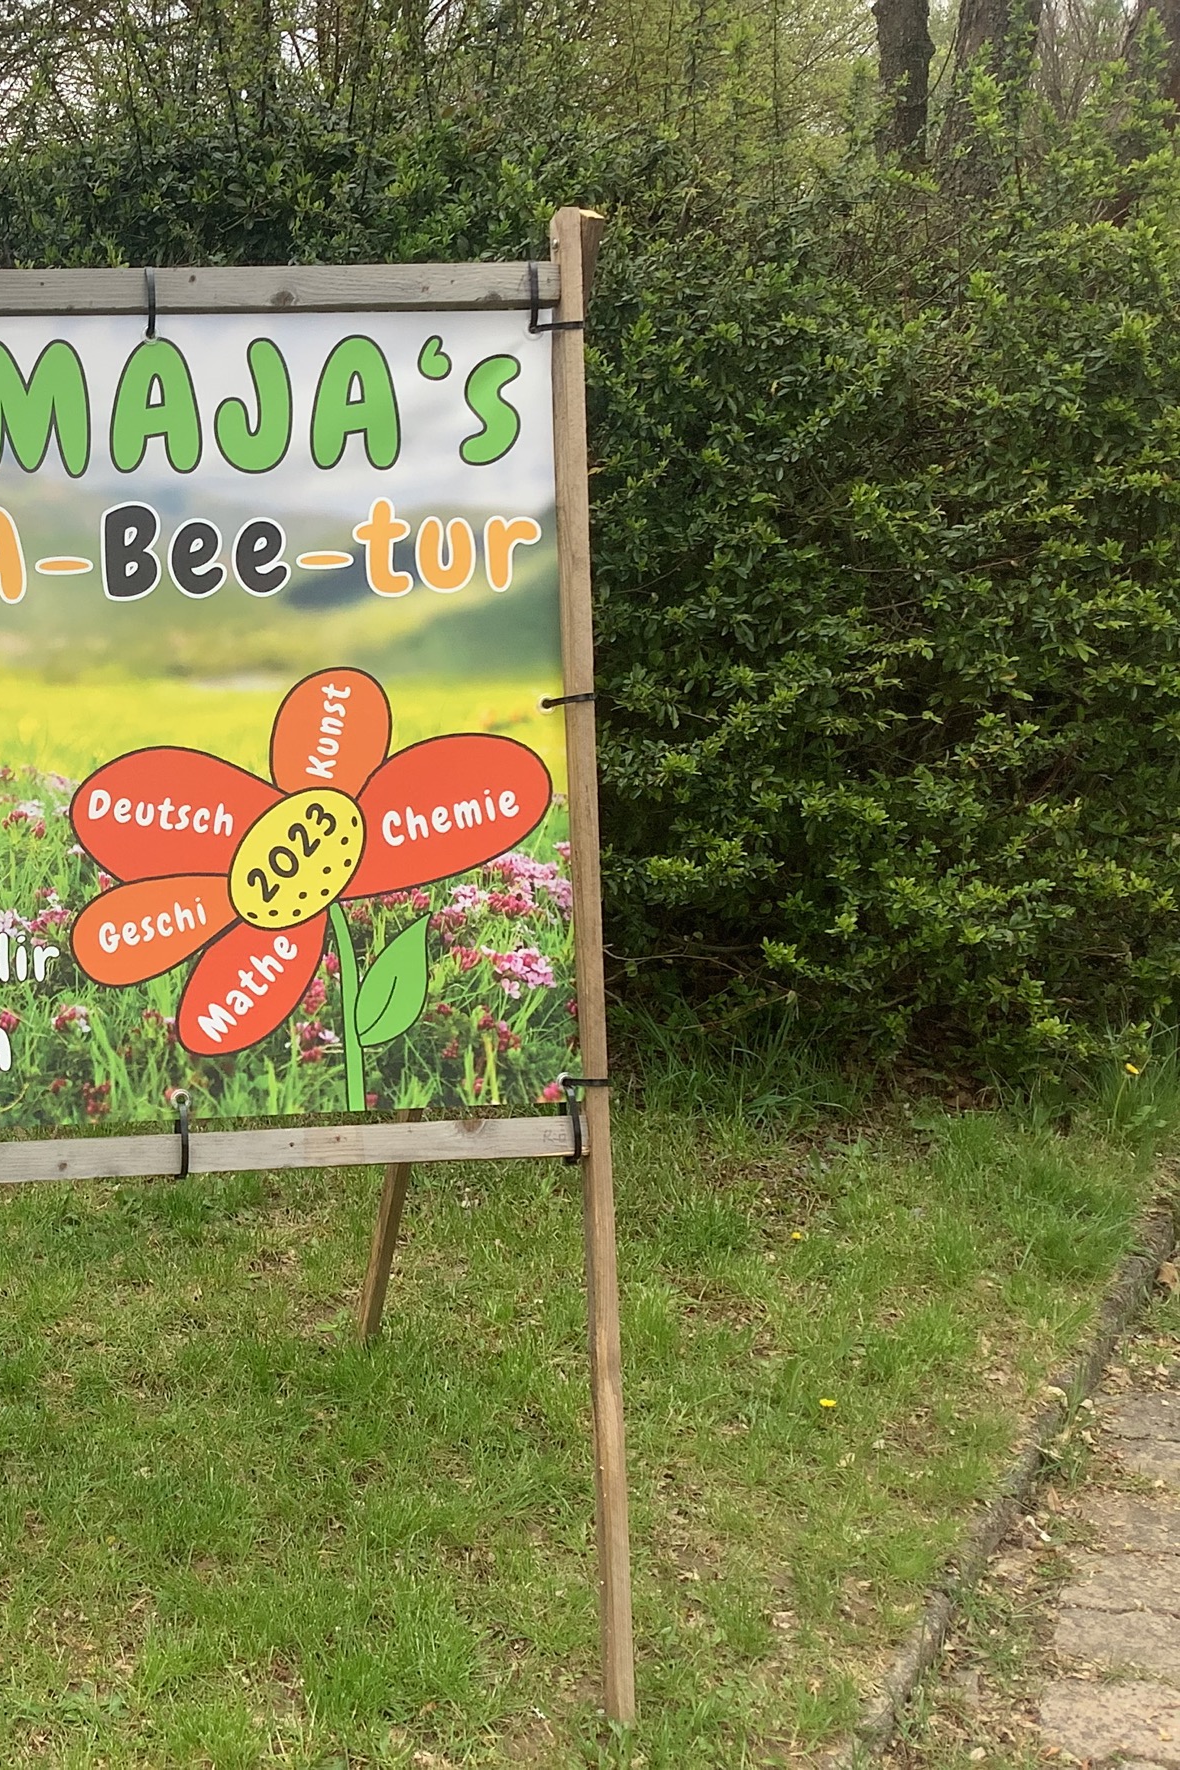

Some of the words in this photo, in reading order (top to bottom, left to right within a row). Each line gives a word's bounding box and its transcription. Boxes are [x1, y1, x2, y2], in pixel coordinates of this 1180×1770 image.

[305, 682, 352, 779] Kunst
[87, 788, 234, 837] Deutsch
[381, 788, 521, 847] Chemie
[246, 802, 337, 903] 2023
[97, 897, 207, 954] Geschi
[197, 934, 298, 1043] Mathe
